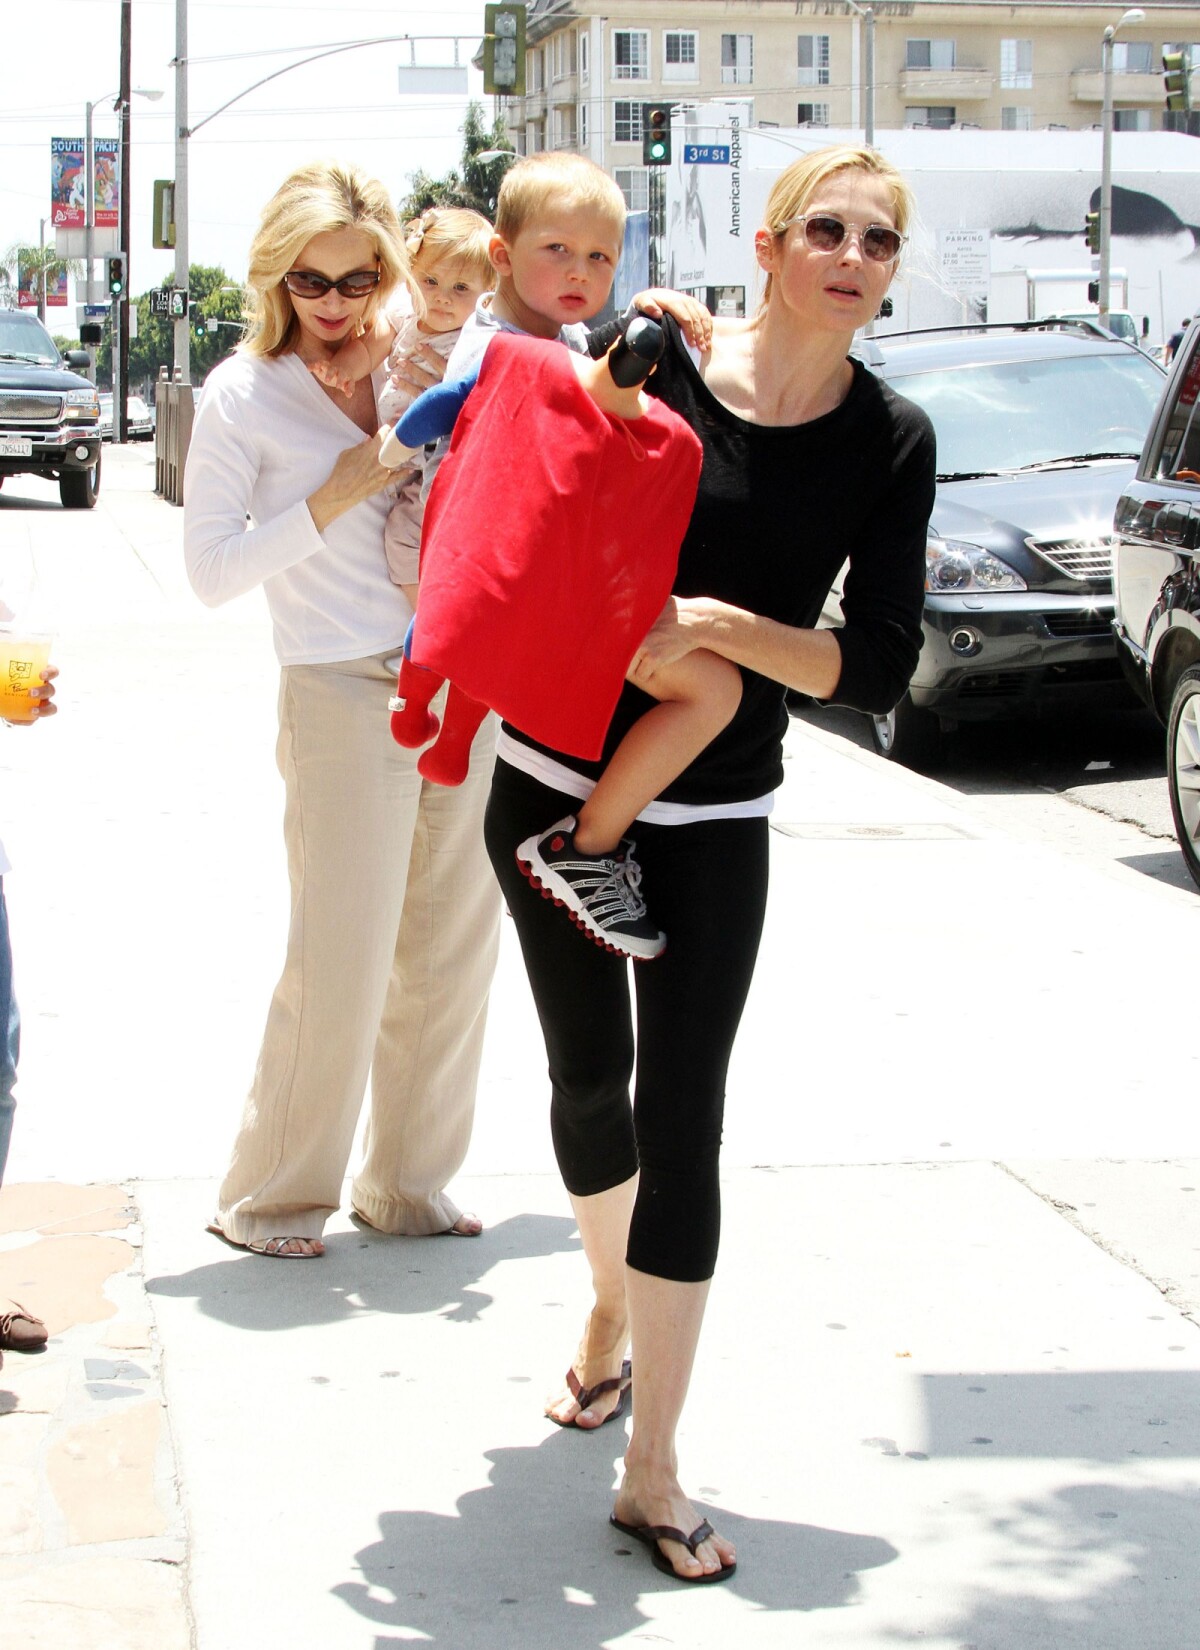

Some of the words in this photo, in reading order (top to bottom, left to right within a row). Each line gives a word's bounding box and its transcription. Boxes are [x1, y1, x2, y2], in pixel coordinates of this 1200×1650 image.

[52, 140, 84, 152] SOUTH
[95, 140, 119, 152] PACIF
[729, 116, 741, 168] Apparel
[689, 147, 709, 161] 3rd
[711, 149, 725, 161] St
[729, 171, 741, 237] American
[945, 234, 984, 242] PARKING
[156, 292, 169, 301] TH
